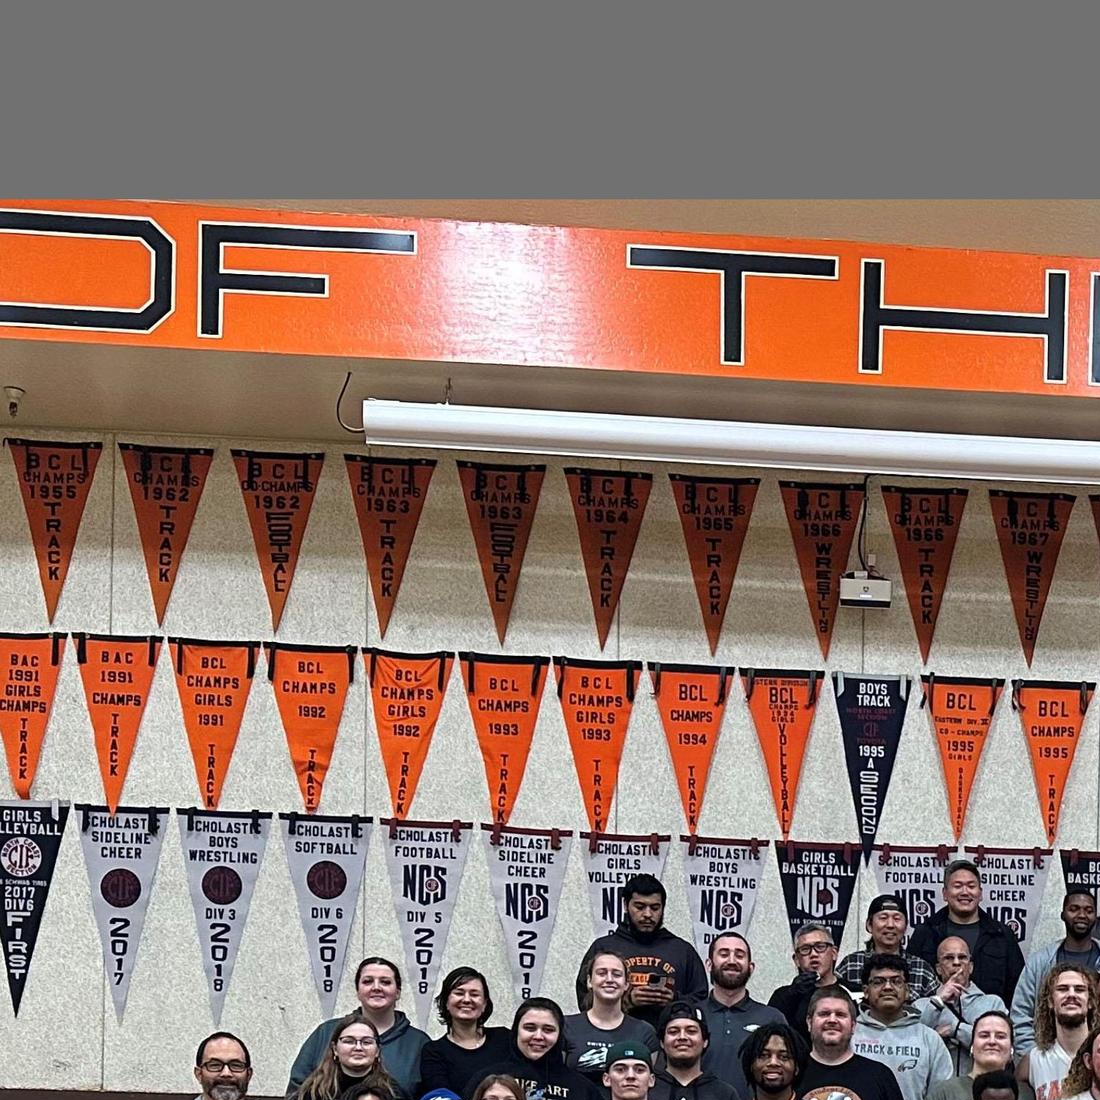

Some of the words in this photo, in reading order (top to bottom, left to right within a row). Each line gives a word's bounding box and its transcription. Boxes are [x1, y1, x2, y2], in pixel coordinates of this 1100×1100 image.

[29, 485, 77, 499] 1955
[255, 496, 300, 509] 1962
[803, 523, 841, 537] 1966
[45, 502, 60, 580] TRACK
[266, 512, 294, 592] FOOTBALL
[815, 543, 832, 633] WRESTLING
[10, 654, 39, 667] BAC
[201, 657, 226, 669] BCL
[298, 661, 323, 674] BCL
[9, 670, 39, 682] 1991
[187, 675, 240, 689] CHAMPS
[395, 669, 422, 682] BCL
[283, 681, 336, 695] CHAMPS
[581, 676, 612, 689] BCL
[859, 683, 888, 694] BOYS
[6, 684, 41, 697] GIRLS
[381, 686, 433, 700] CHAMPS
[195, 694, 232, 707] GIRLS
[569, 694, 622, 708] CHAMPS
[857, 695, 890, 707] TRACK
[299, 705, 326, 718] 1992
[388, 704, 426, 717] GIRLS
[198, 713, 224, 727] 1991
[576, 711, 615, 724] GIRLS
[393, 724, 420, 737] 1992
[582, 728, 611, 741] 1993
[19, 718, 28, 779] TRACK
[859, 745, 884, 757] 1995
[867, 758, 874, 769] A
[206, 744, 216, 807] TRACK
[306, 749, 316, 804] TRACK
[397, 752, 409, 814] TRACK
[593, 760, 602, 832] TRACK
[859, 771, 879, 834] SECOND
[3, 810, 41, 822] GIRLS
[92, 831, 151, 845] SIDELINE
[209, 836, 238, 848] BOYS
[101, 847, 141, 859] CHEER
[295, 842, 357, 855] SOFTBALL
[394, 846, 457, 859] FOOTBALL
[188, 850, 258, 864] WRESTLING
[498, 851, 554, 864] SIDELINE
[802, 852, 836, 863] GIRLS
[508, 865, 546, 878] CHEER
[709, 862, 738, 874] BOYS
[782, 863, 854, 876] BASKETBALL
[690, 874, 756, 889] WRESTLING
[4, 887, 35, 898] 2017
[205, 908, 225, 920] DIV
[229, 909, 236, 920] 3
[311, 907, 330, 918] DIV
[336, 908, 343, 919] 6
[407, 911, 427, 922] DIV
[434, 912, 442, 923] 5
[6, 912, 30, 979] FIRST
[109, 918, 130, 985] 2017
[210, 923, 231, 991] 2018
[317, 925, 338, 992] 2018
[414, 928, 435, 994] 2018
[517, 930, 538, 999] 2018
[663, 963, 675, 974] OF
[855, 1044, 885, 1055] TRACK
[896, 1047, 920, 1057] FIELD
